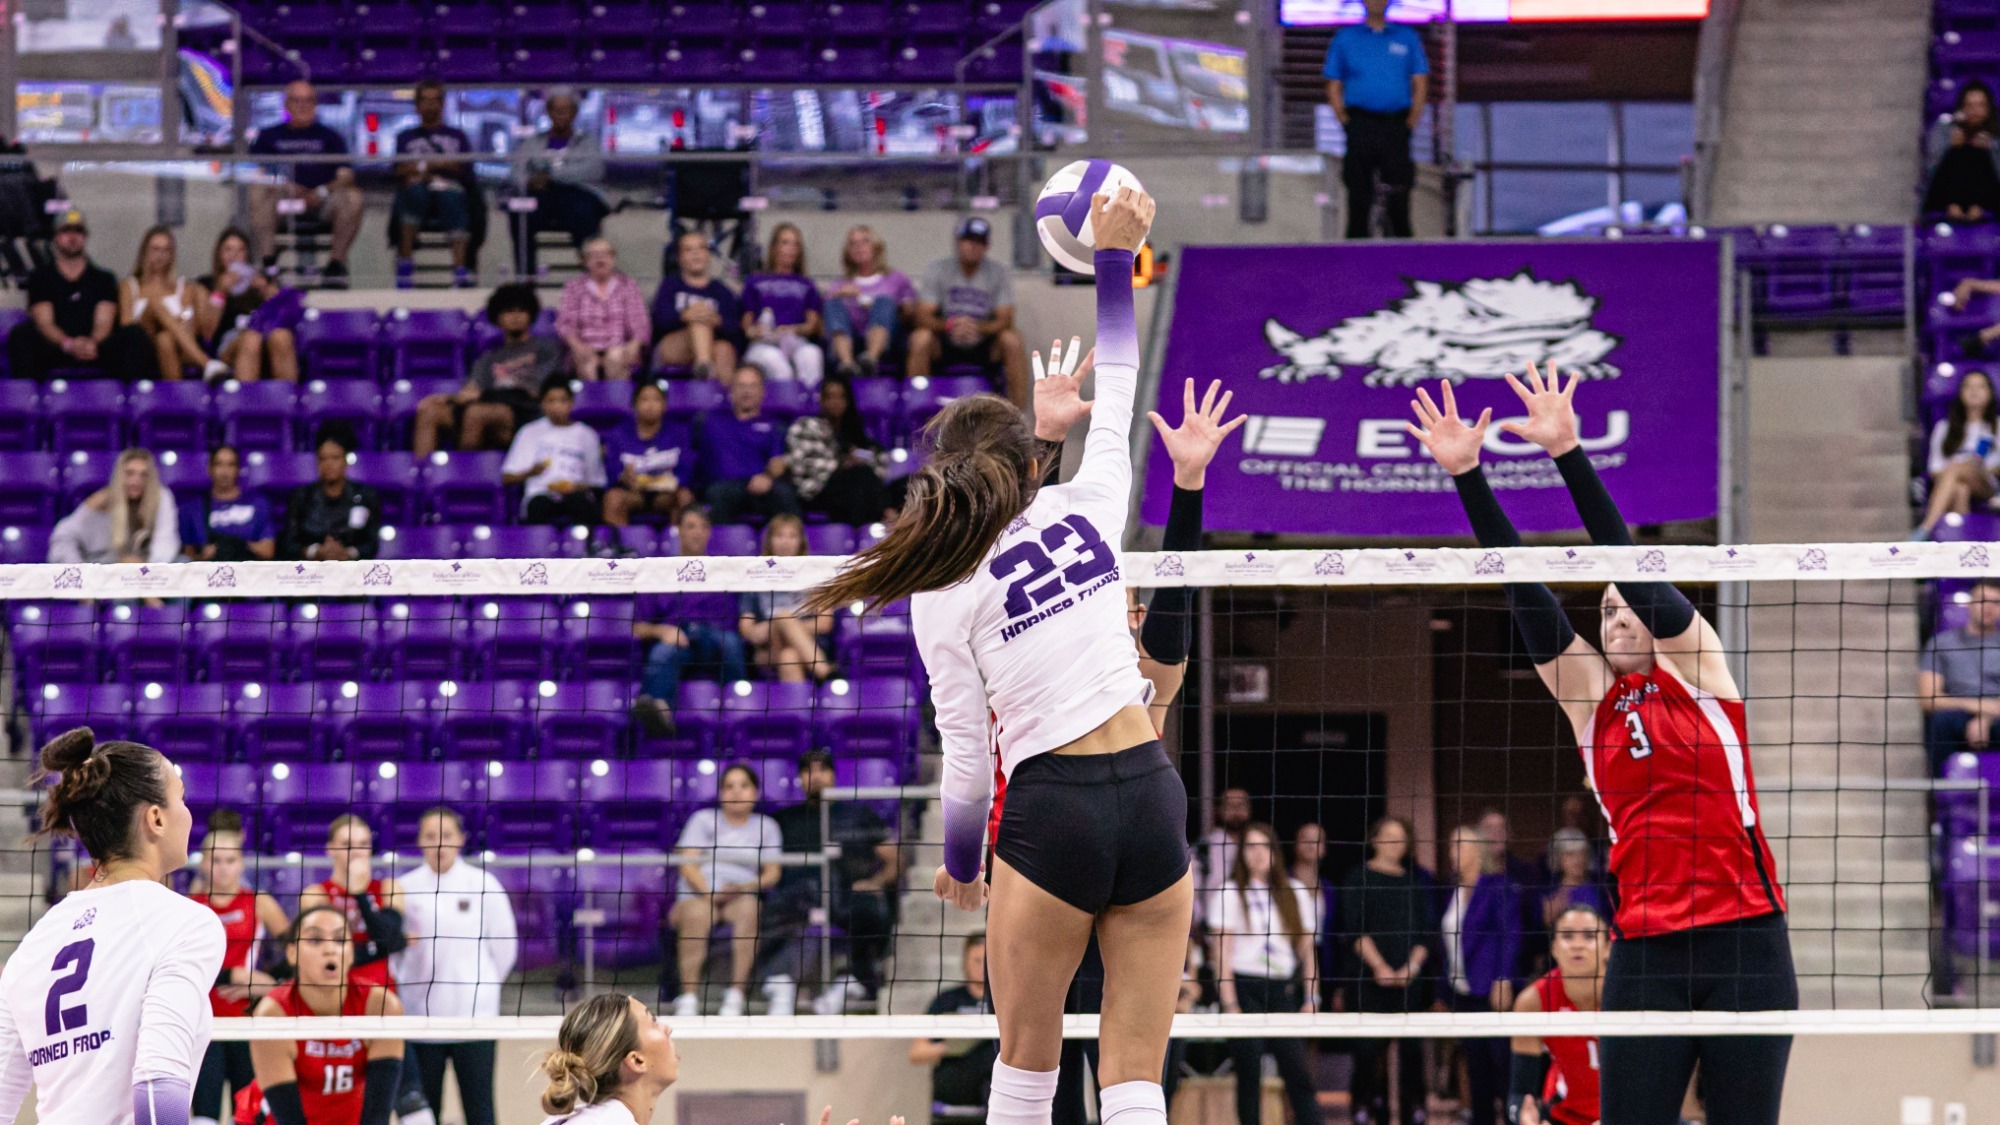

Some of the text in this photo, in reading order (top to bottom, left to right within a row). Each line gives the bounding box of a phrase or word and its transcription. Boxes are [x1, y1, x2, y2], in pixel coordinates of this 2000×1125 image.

[1356, 410, 1629, 458] ECU
[1370, 461, 1450, 479] CRED
[1481, 457, 1561, 475] UNIO
[1485, 472, 1567, 490] ROGS
[989, 513, 1116, 619] 23
[1624, 710, 1653, 760] 3
[45, 937, 96, 1036] 2
[73, 1029, 112, 1055] FRO
[322, 1064, 354, 1096] 16
